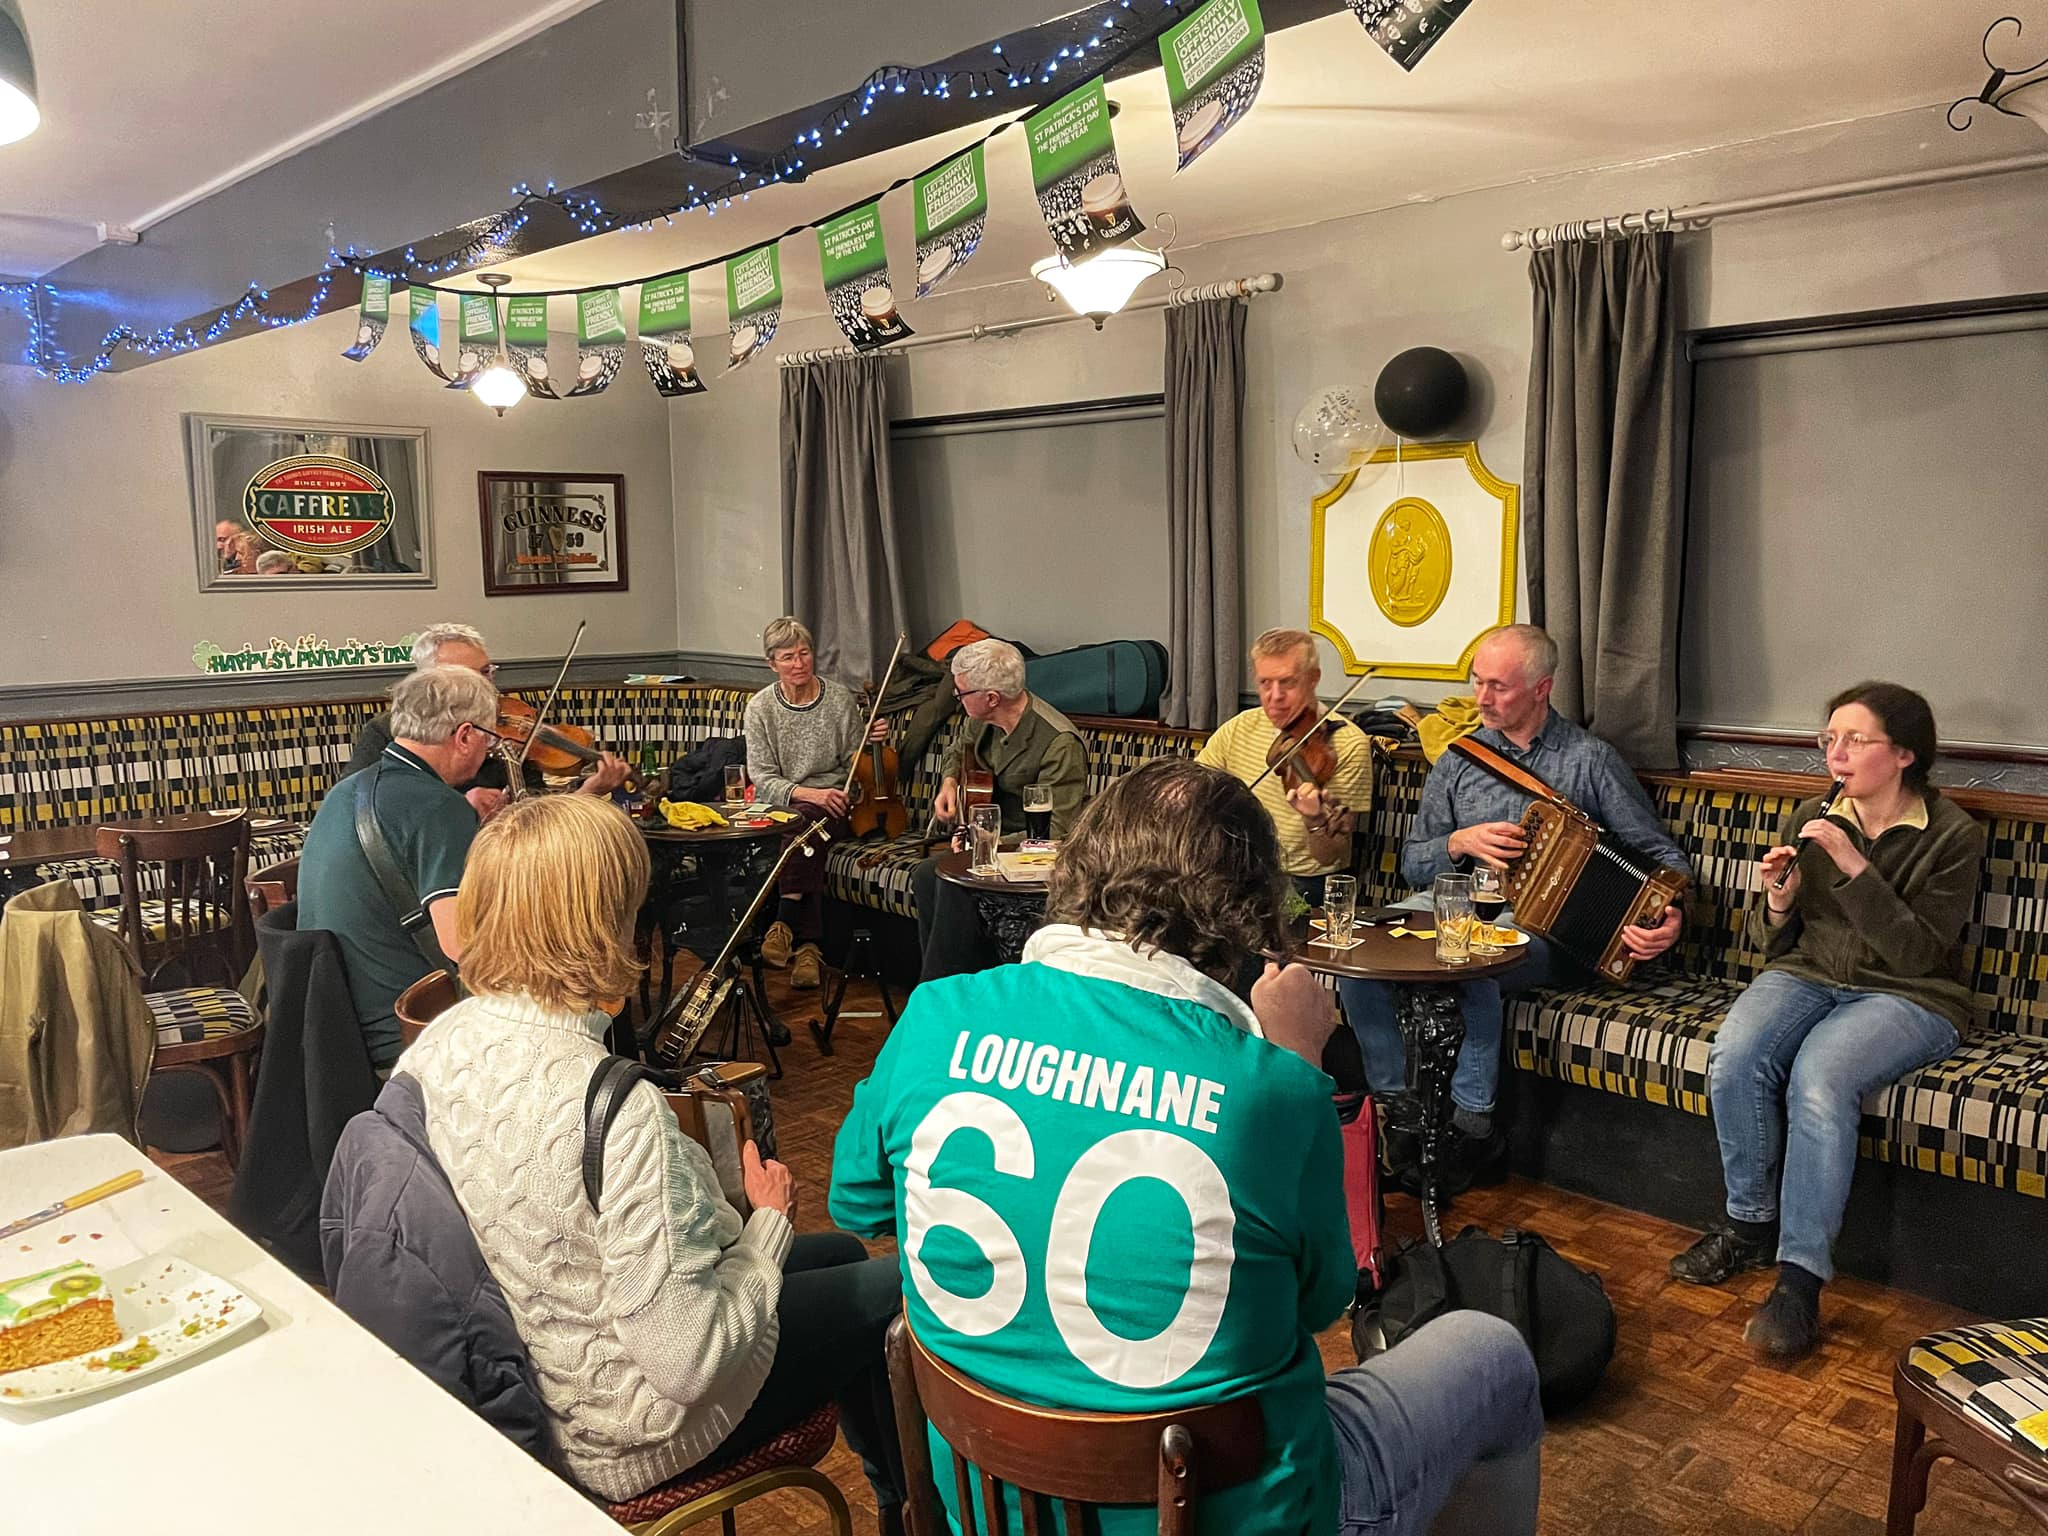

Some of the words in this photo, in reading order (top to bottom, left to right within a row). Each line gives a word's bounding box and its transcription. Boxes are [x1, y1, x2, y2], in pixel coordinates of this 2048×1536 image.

[1180, 0, 1236, 58] OFFICIALLY
[1200, 2, 1224, 27] MAKE
[1182, 8, 1239, 70] FRIENDLY
[1034, 130, 1044, 144] ST
[1044, 106, 1082, 137] PATRICK'S
[1082, 96, 1098, 113] DAY
[927, 164, 971, 203] OFFICIALLY
[928, 174, 972, 214] FRIENDLY
[293, 525, 325, 534] IRISH
[330, 525, 352, 534] ALE
[503, 505, 607, 533] GUINNESS
[211, 652, 267, 673] HAPPY
[949, 1030, 1225, 1134] LOUGHNANE
[904, 1091, 1236, 1388] 60
